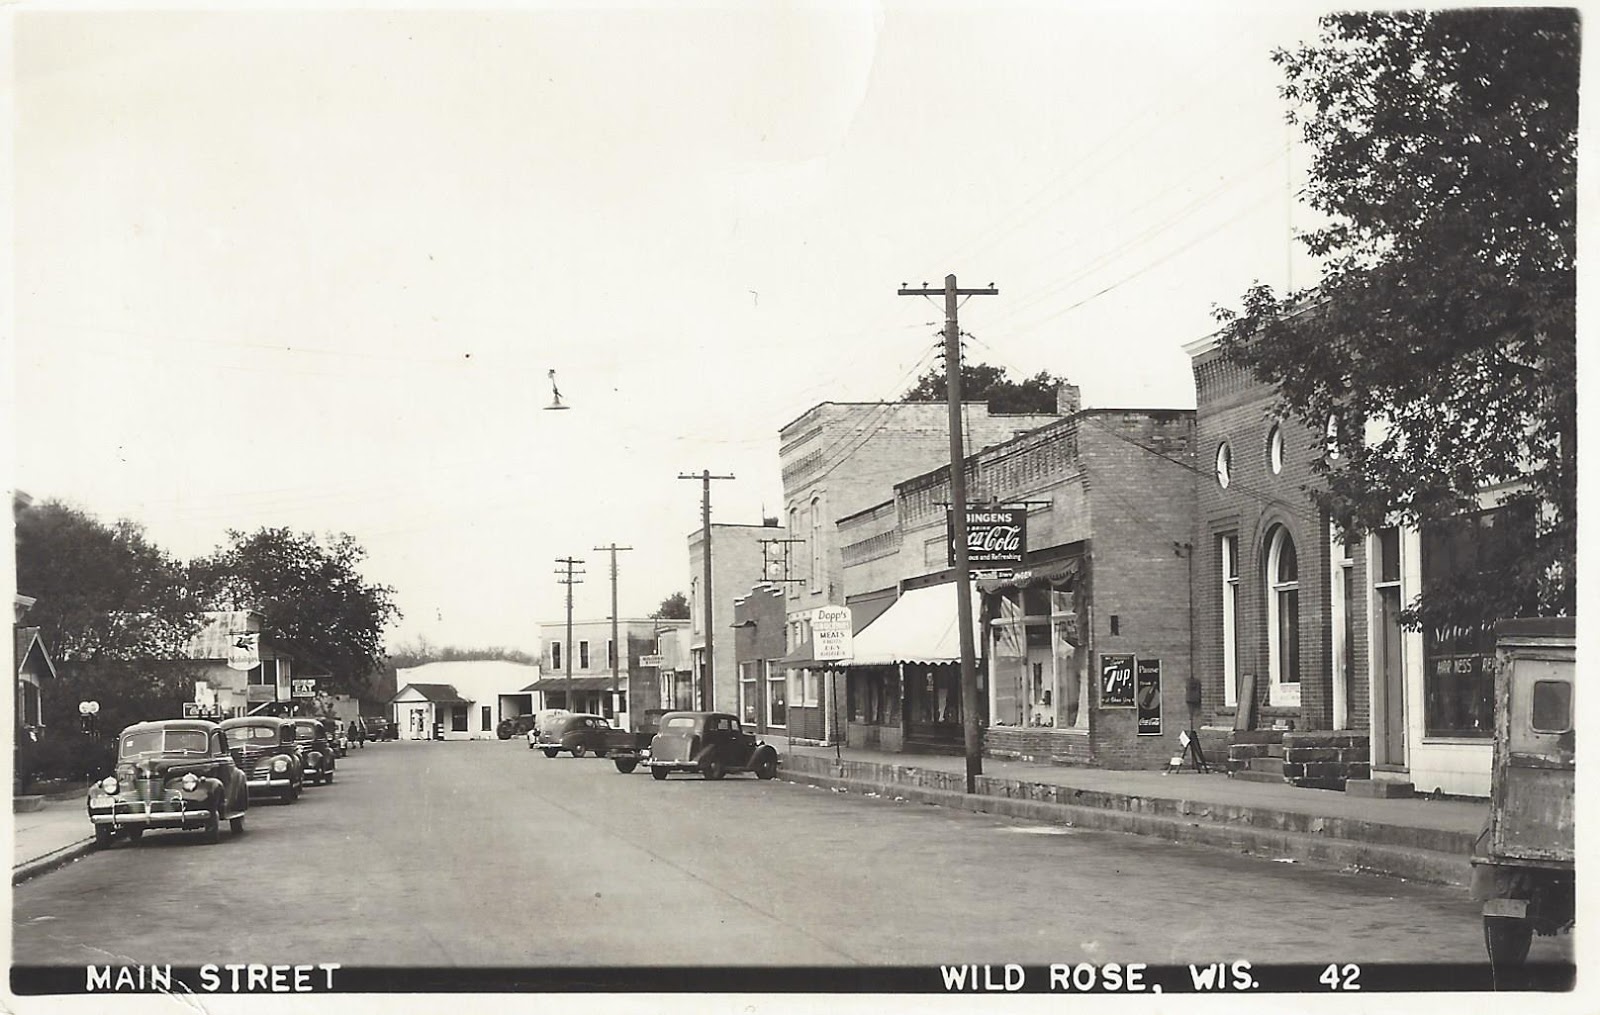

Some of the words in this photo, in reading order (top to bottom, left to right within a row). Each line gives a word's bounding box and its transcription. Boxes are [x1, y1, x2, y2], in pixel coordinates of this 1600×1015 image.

[952, 525, 1021, 551] ca-Cola
[1139, 665, 1159, 674] Pause
[294, 684, 314, 693] EAT
